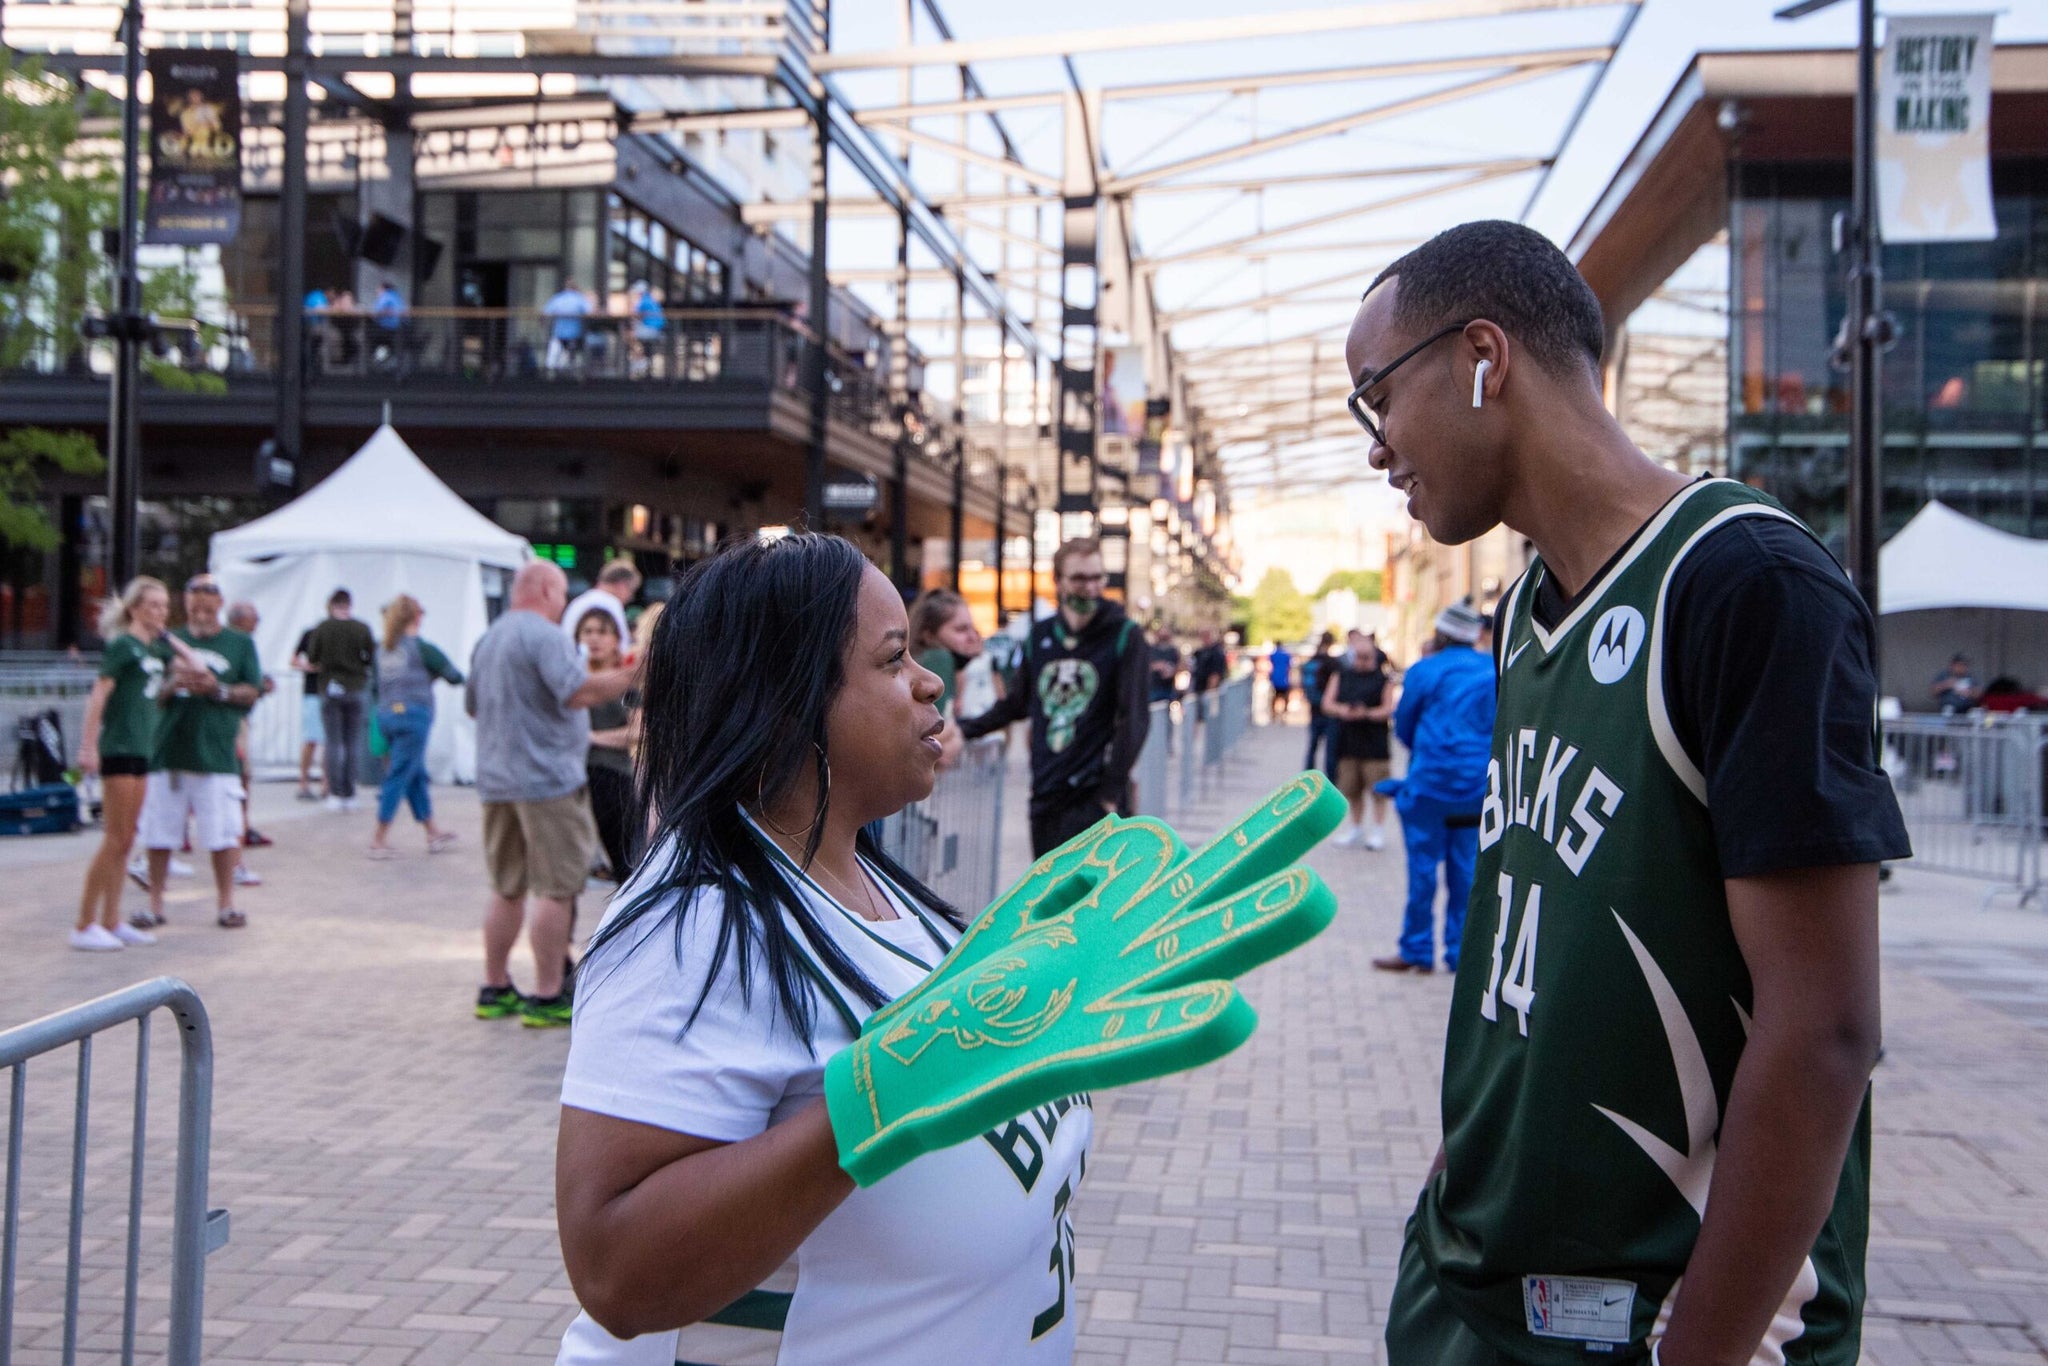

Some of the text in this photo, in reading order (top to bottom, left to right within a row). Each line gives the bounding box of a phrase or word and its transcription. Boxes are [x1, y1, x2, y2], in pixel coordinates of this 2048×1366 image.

[1896, 35, 1978, 74] HISTORY
[1896, 97, 1970, 132] MAKING
[1479, 728, 1625, 878] BUCKS
[1480, 870, 1543, 1038] 34
